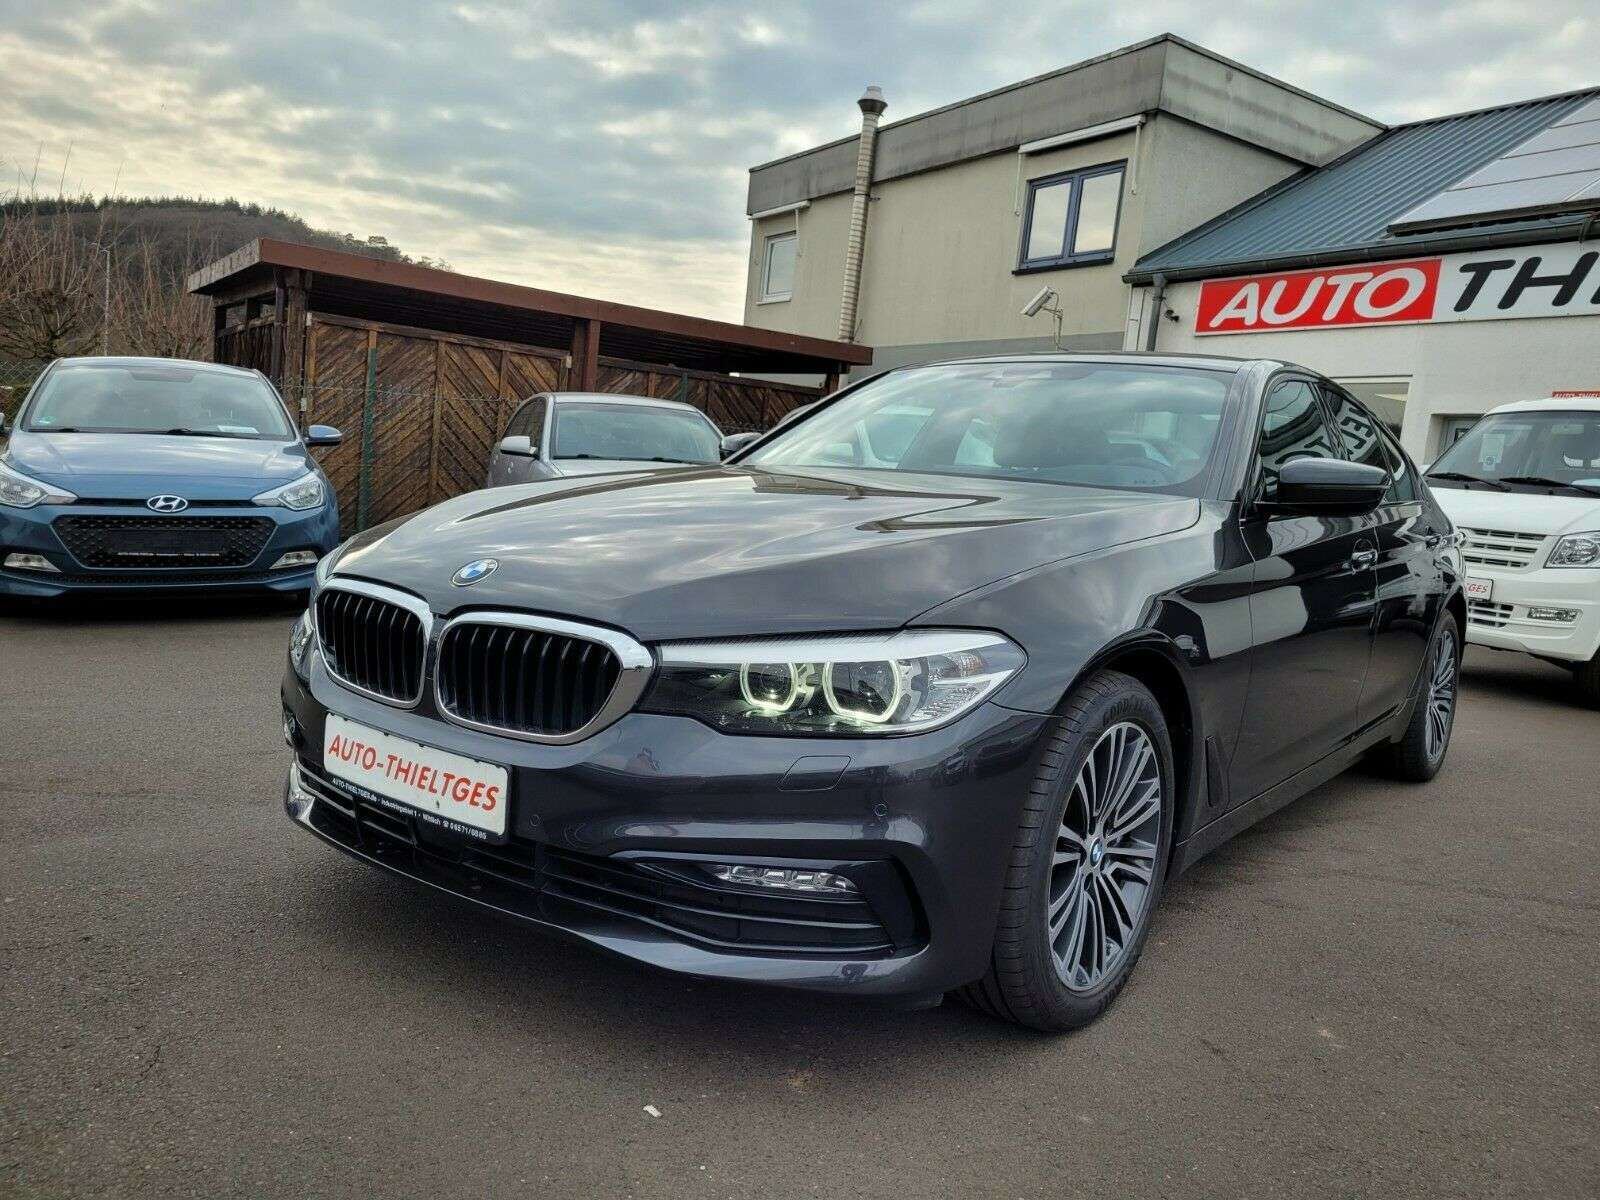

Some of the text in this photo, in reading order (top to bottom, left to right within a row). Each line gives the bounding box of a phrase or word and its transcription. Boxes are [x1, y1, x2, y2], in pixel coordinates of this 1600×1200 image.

[1209, 251, 1600, 328] AUTO TH
[328, 735, 499, 811] AUTO-THIELTGES
